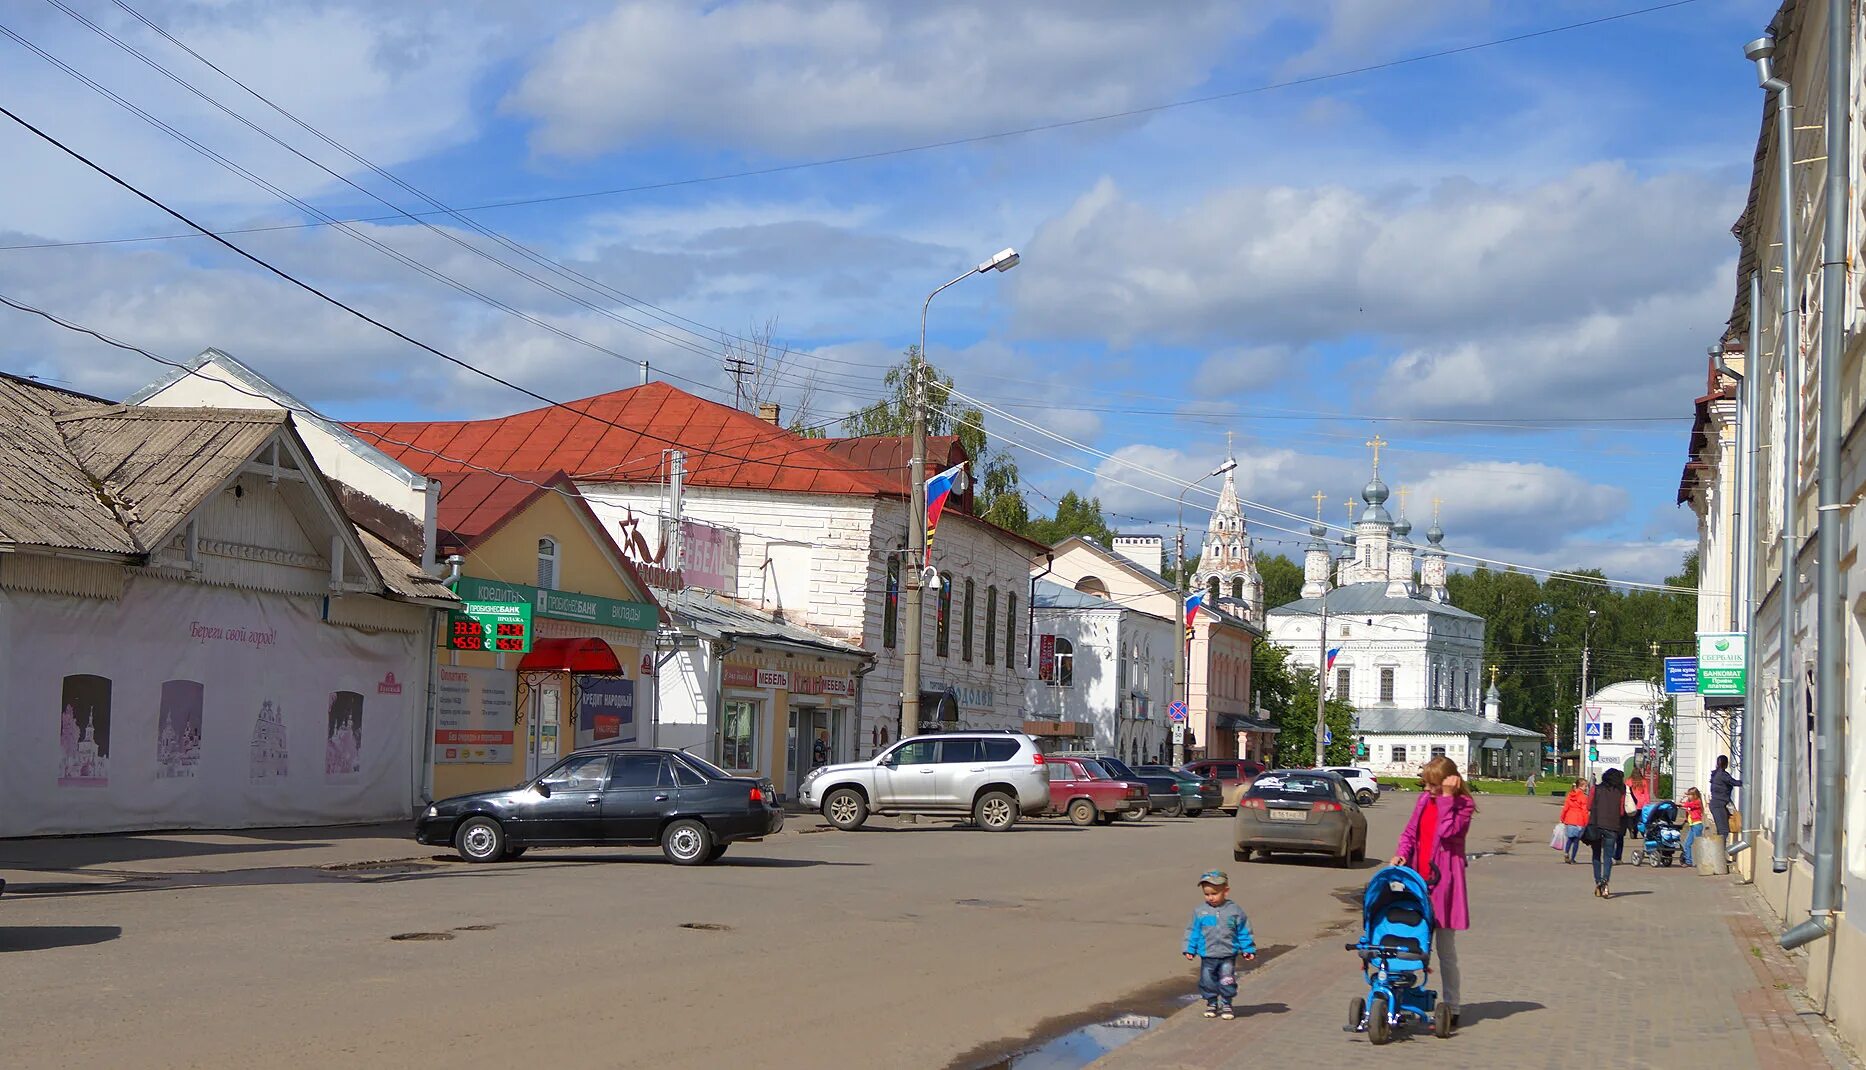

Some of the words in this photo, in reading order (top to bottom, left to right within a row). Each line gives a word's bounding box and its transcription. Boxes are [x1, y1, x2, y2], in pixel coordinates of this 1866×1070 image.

[469, 604, 520, 614] ПРОБИЗНЕСБАНК
[478, 585, 519, 603] кредиты
[548, 596, 597, 615] ПРОБИЗНЕСБАНК
[611, 605, 640, 622] вклады
[189, 621, 223, 644] Береги
[225, 626, 247, 642] свой
[248, 626, 277, 649] город!
[759, 672, 787, 686] МЕБЕЛЬ
[821, 678, 846, 692] МЕБЕЛЬ
[582, 692, 603, 707] КРЕДИТ
[604, 693, 632, 708] НАРОДНЫЙ
